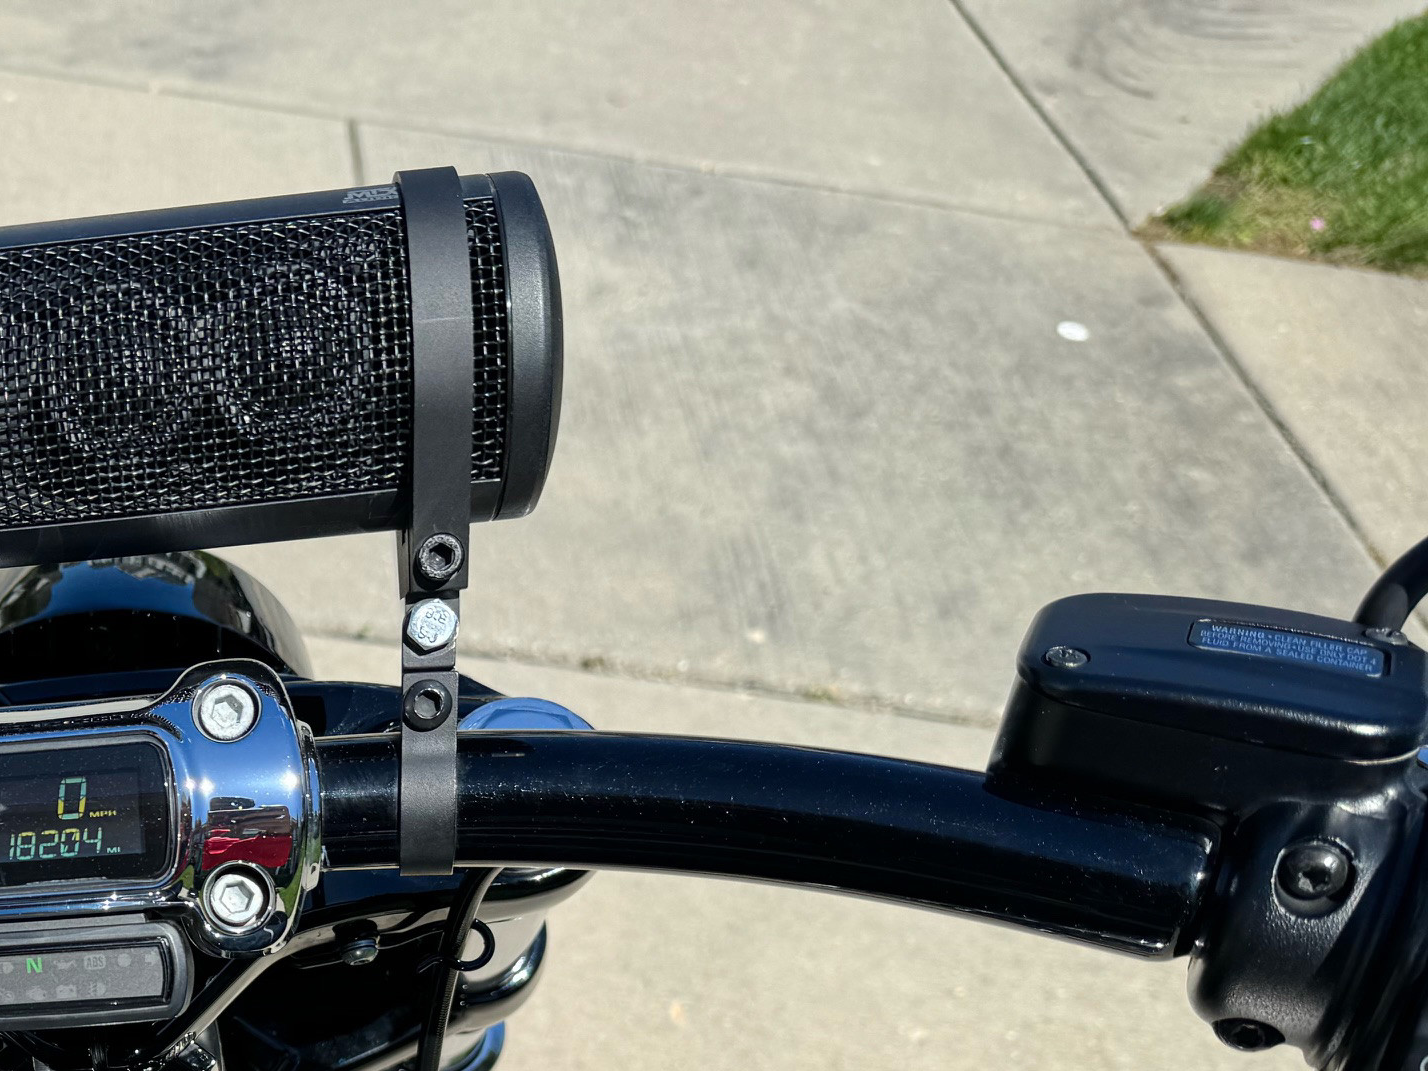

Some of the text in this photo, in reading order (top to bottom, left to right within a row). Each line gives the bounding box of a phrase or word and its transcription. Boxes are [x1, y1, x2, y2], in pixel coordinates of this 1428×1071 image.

[1200, 629, 1237, 641] BEFORE
[1319, 649, 1346, 660] ONLY
[1347, 653, 1367, 664] DOT
[1201, 636, 1373, 672] FLUID FROM A SEALED CONTAINER
[1211, 624, 1367, 656] WARNING CLEAN FILLER CAP
[57, 776, 117, 820] 0 MPH
[106, 846, 121, 854] MI
[26, 955, 106, 974] N ABS
